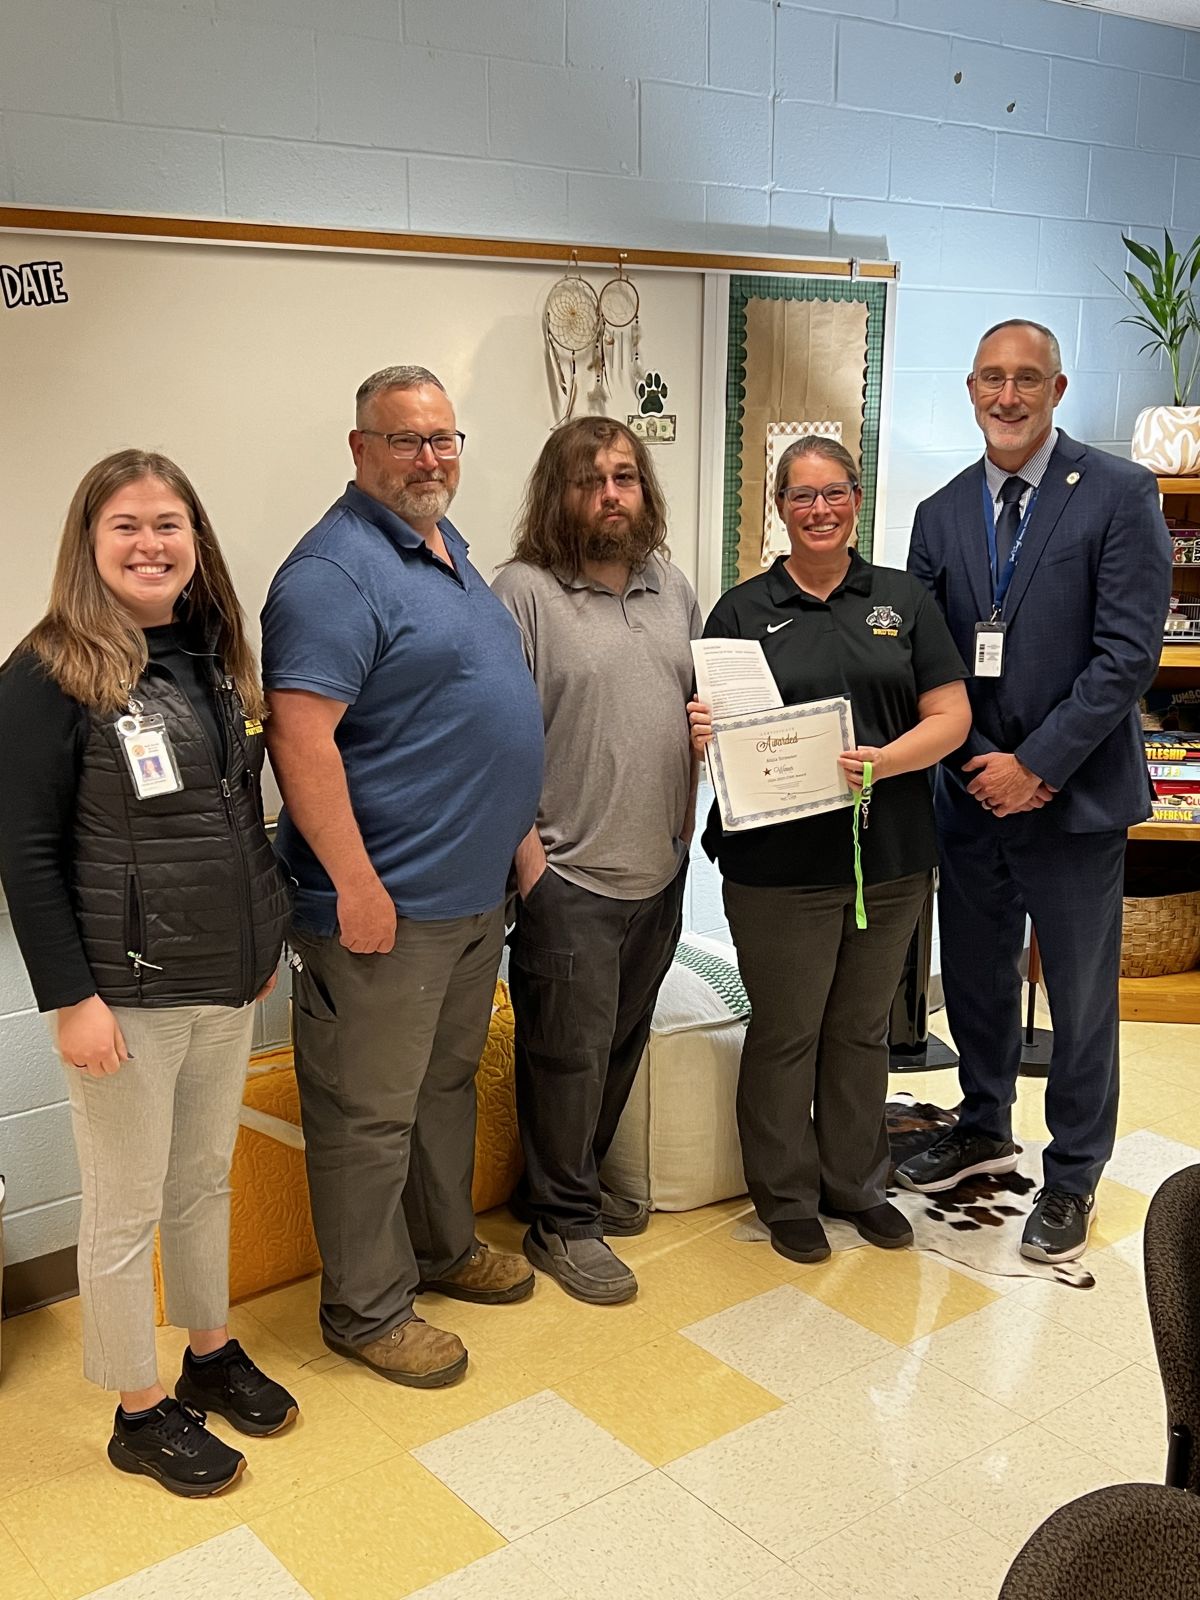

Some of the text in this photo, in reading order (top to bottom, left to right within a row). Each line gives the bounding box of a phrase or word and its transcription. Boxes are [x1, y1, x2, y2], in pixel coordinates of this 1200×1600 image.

[0, 261, 68, 308] DATE
[756, 732, 798, 753] Awarded
[1150, 766, 1180, 778] LIFE
